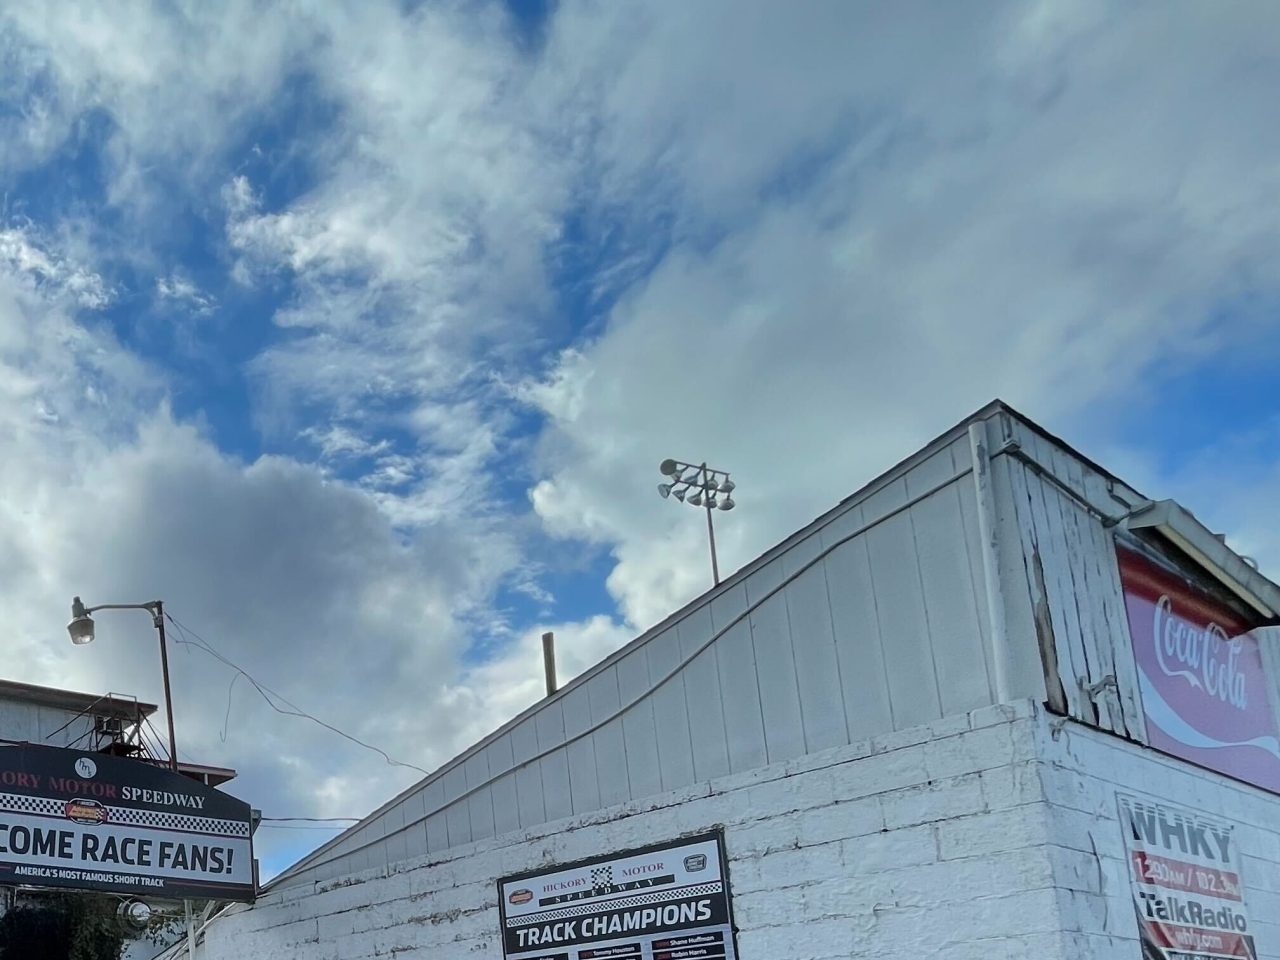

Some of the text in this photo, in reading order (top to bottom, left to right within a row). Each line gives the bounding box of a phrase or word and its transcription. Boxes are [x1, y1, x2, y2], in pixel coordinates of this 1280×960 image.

[48, 772, 117, 798] MOTOR
[121, 786, 206, 810] SPEEDWAY
[1123, 803, 1231, 863] WHKY
[81, 833, 151, 867] RACE
[159, 841, 234, 875] FANS!
[15, 866, 165, 888] AMERICA'S MOST FAMOUS SHORT TRACK
[543, 877, 588, 893] HICKORY
[622, 862, 665, 878] MOTOR
[555, 878, 655, 903] SPEEDWAY
[516, 899, 712, 947] TRACK CHAMPIONS
[1139, 891, 1247, 933] TalkRadio
